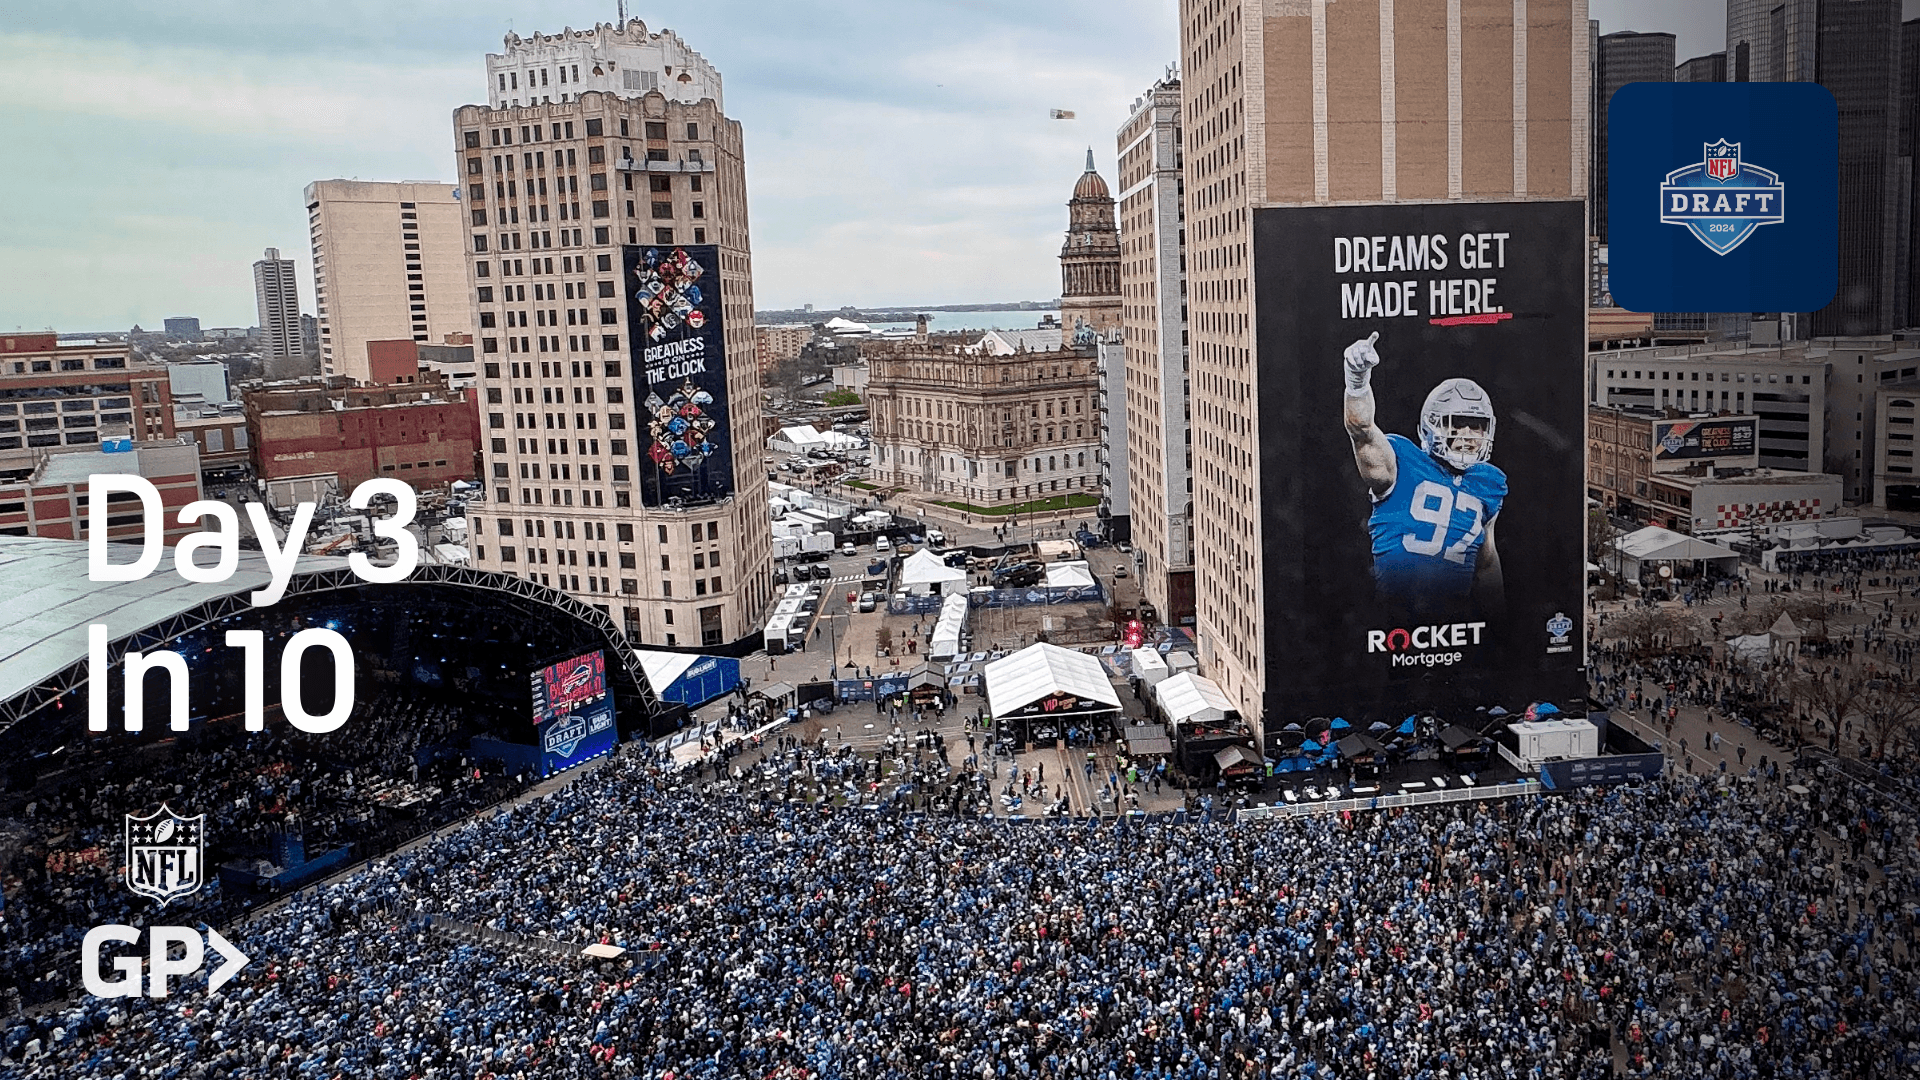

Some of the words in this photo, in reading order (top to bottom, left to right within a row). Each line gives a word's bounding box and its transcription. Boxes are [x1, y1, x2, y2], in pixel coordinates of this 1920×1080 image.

[1334, 234, 1448, 273] DREAMS
[1459, 233, 1510, 270] GET
[1341, 281, 1418, 319] MADE
[1429, 278, 1503, 315] HERE.
[644, 336, 705, 363] GREATNESS
[672, 354, 685, 363] ON
[645, 367, 666, 385] THE
[668, 358, 706, 380] CLOCK
[112, 440, 120, 450] 7
[1403, 481, 1483, 564] 97
[1368, 622, 1486, 653] ROCKET
[1392, 651, 1463, 667] Mortgage
[1043, 699, 1058, 712] VIP
[590, 718, 612, 733] LIGHT
[592, 713, 608, 725] BUD
[548, 725, 583, 748] DRAFT
